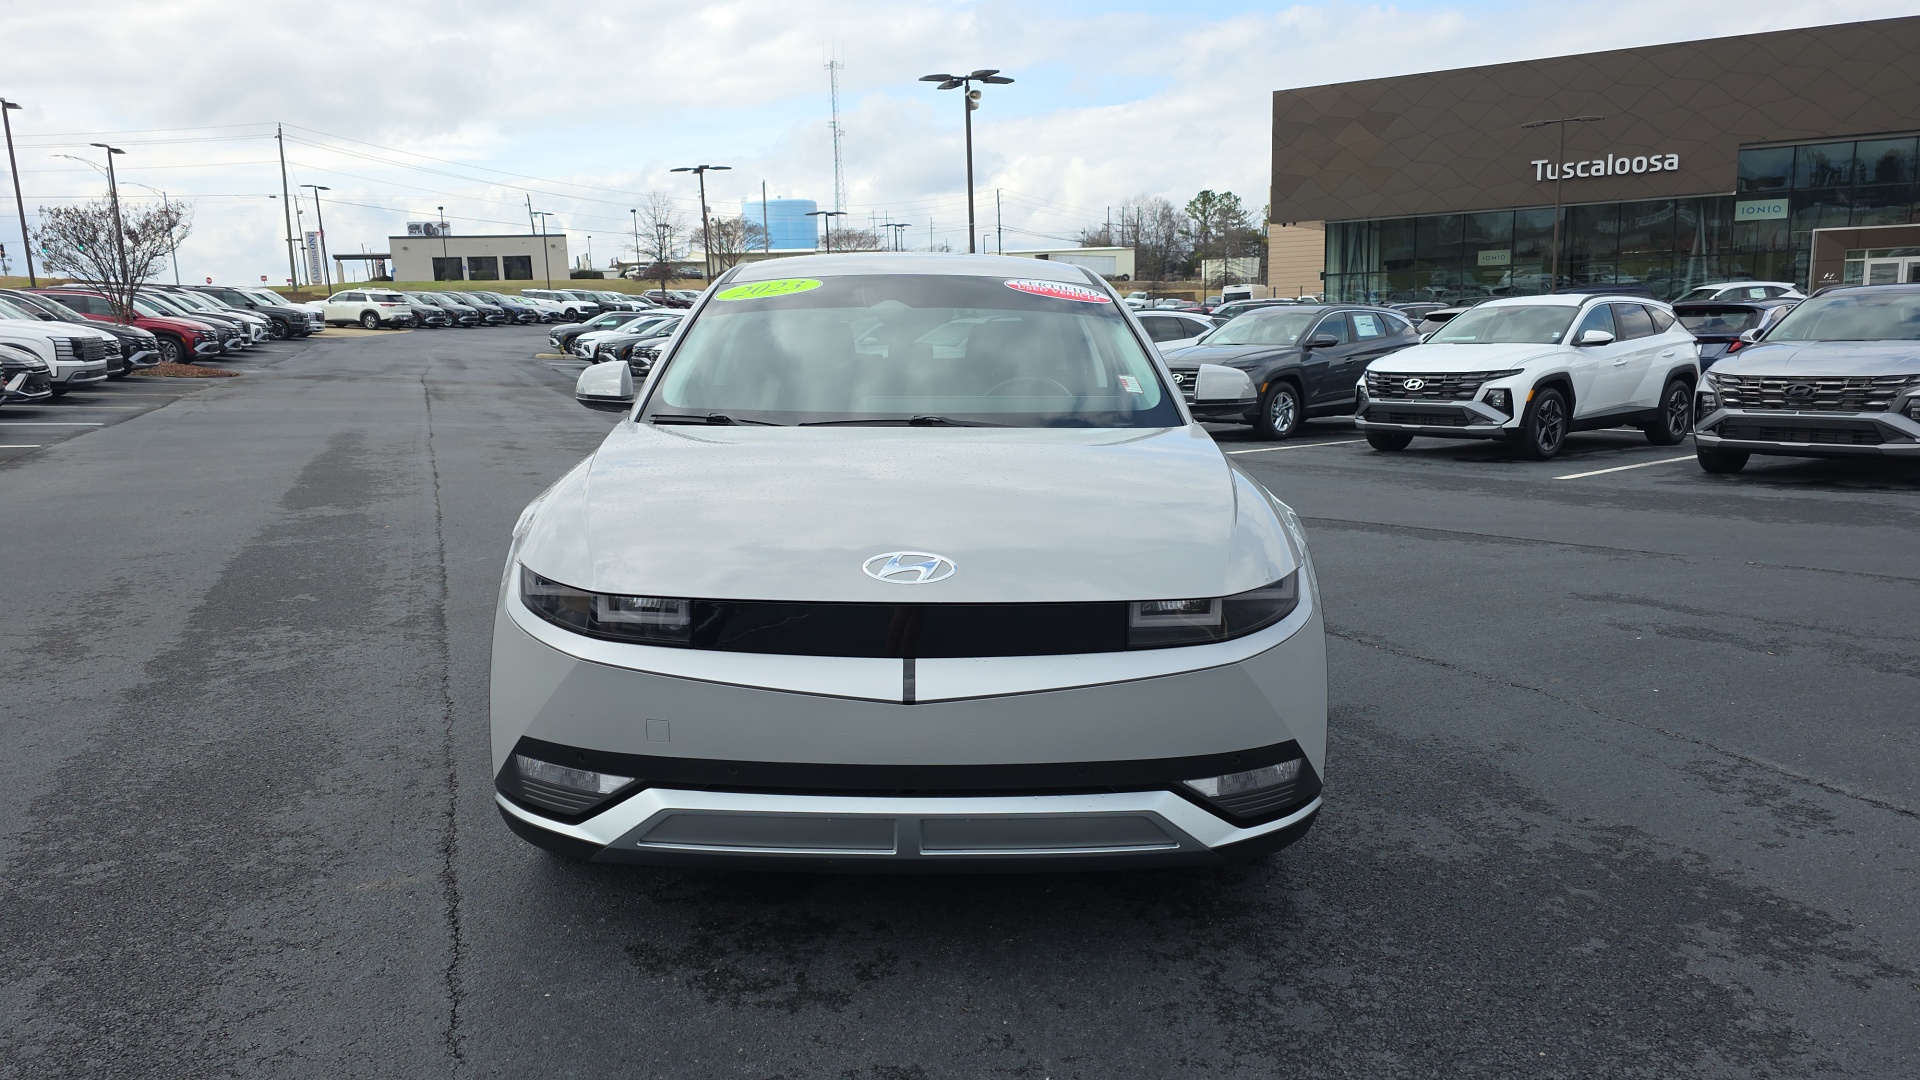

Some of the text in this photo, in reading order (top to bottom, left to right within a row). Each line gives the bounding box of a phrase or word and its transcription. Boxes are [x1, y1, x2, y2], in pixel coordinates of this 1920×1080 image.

[1531, 154, 1679, 181] Tuscaloosa
[1741, 205, 1782, 215] IONIQ
[731, 280, 806, 298] 2023
[1016, 279, 1099, 297] CERTIFIED
[1017, 284, 1101, 302] USED VEHICLE
